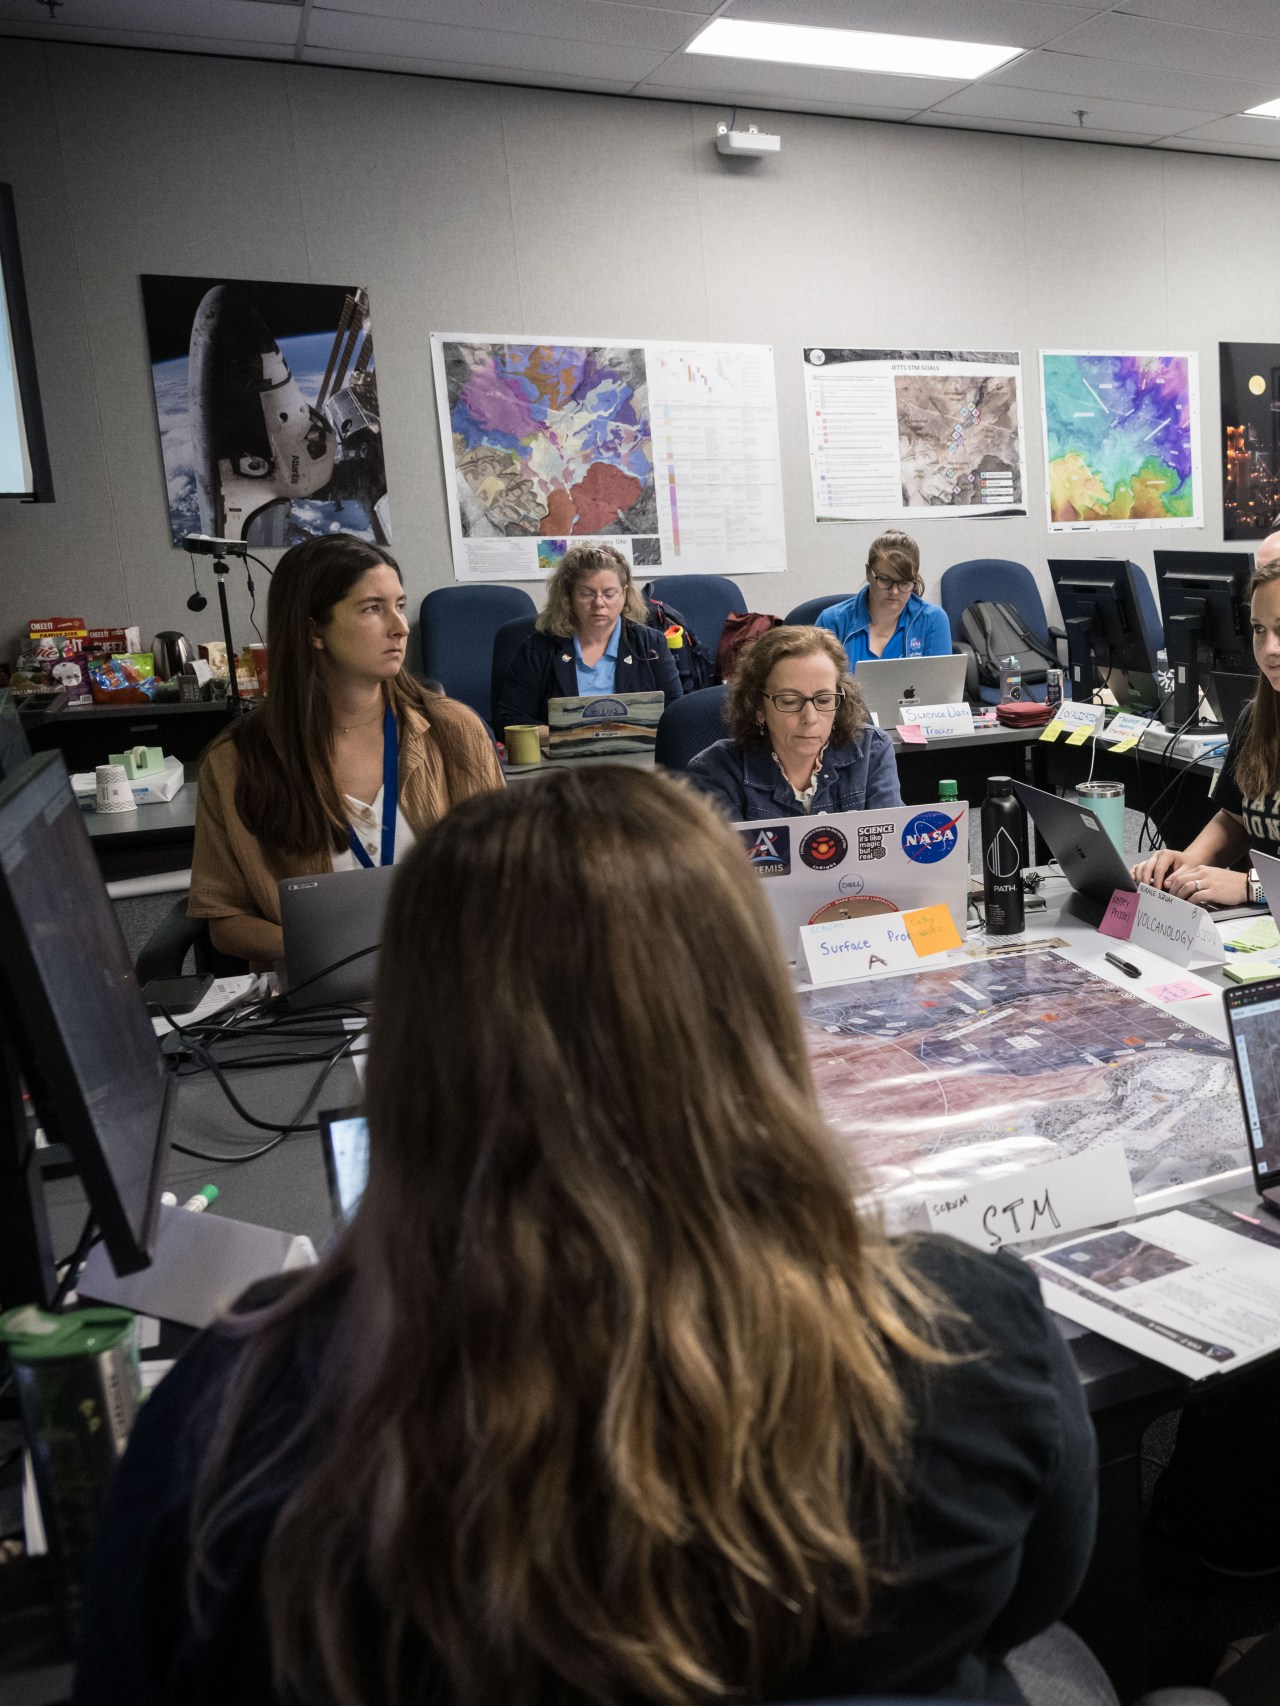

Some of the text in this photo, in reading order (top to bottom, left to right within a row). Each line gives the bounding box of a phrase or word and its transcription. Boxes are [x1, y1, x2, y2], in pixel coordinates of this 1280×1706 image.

[291, 455, 300, 484] Atlantis
[905, 708, 946, 721] Science
[858, 825, 893, 835] SCIENCE
[905, 829, 955, 846] NASA
[754, 864, 783, 874] TEMIS
[1112, 896, 1130, 908] Kelsey
[1137, 910, 1194, 950] VOLCANOLOGY
[821, 940, 871, 956] Surface
[869, 954, 887, 970] A
[933, 1195, 969, 1216] SCRUM
[983, 1189, 1061, 1246] STM
